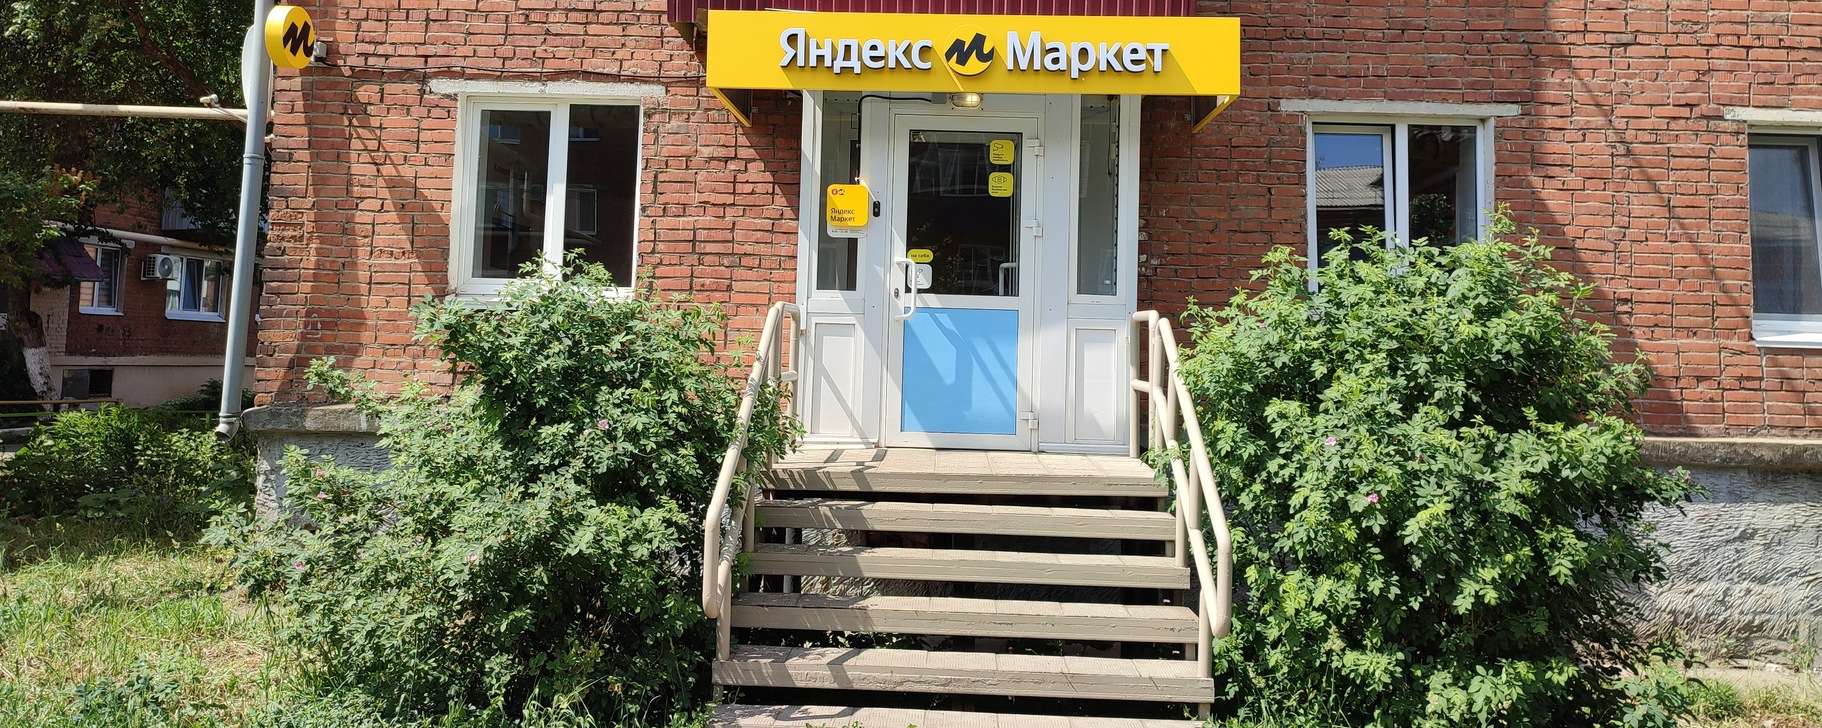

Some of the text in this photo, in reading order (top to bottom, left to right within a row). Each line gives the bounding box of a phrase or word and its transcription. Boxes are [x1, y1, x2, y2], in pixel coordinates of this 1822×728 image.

[779, 27, 933, 74] Яндекс
[1006, 30, 1170, 79] Маркет
[830, 207, 855, 215] Яндекс
[830, 215, 855, 223] Маркет
